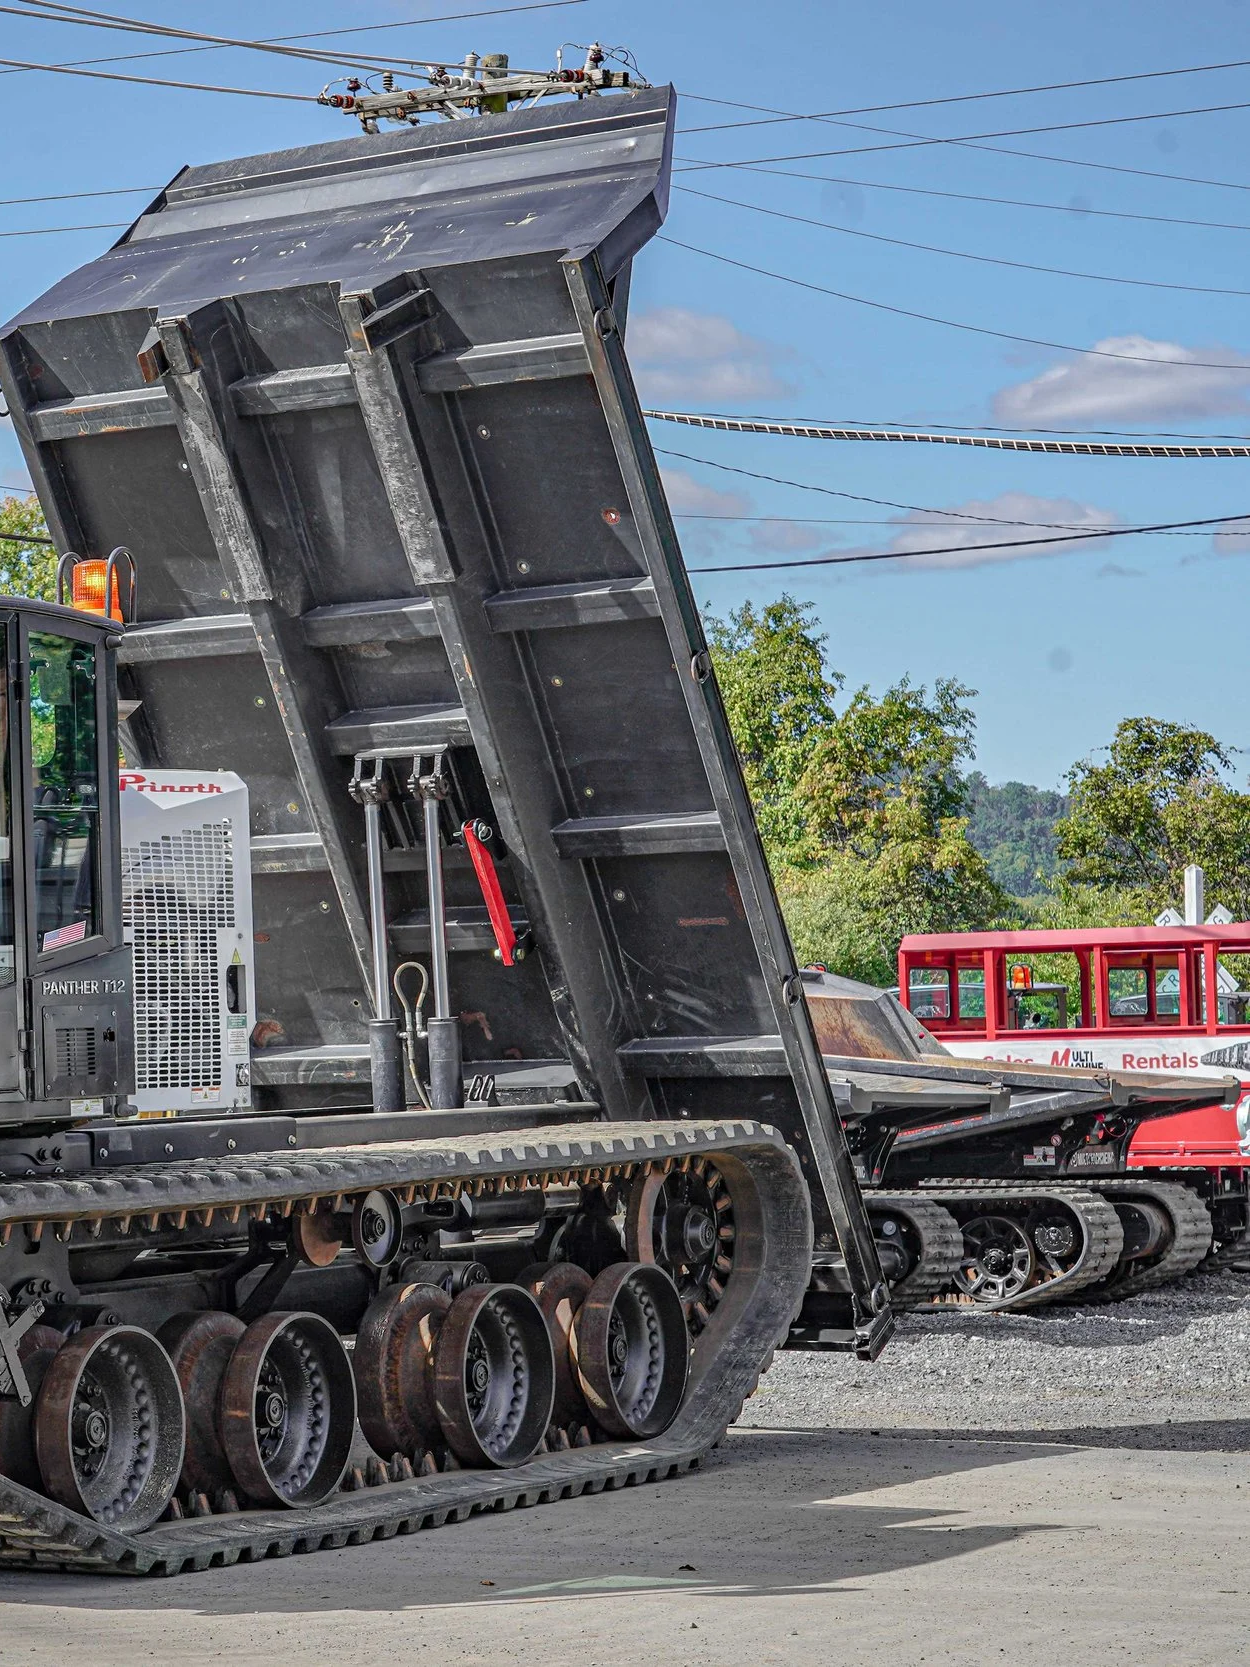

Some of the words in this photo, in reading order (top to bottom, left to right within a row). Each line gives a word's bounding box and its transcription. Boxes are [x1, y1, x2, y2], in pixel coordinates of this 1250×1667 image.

[119, 774, 224, 793] Prinoth
[42, 980, 99, 995] PANTHER
[102, 979, 126, 993] T12
[1122, 1052, 1199, 1069] Rentals
